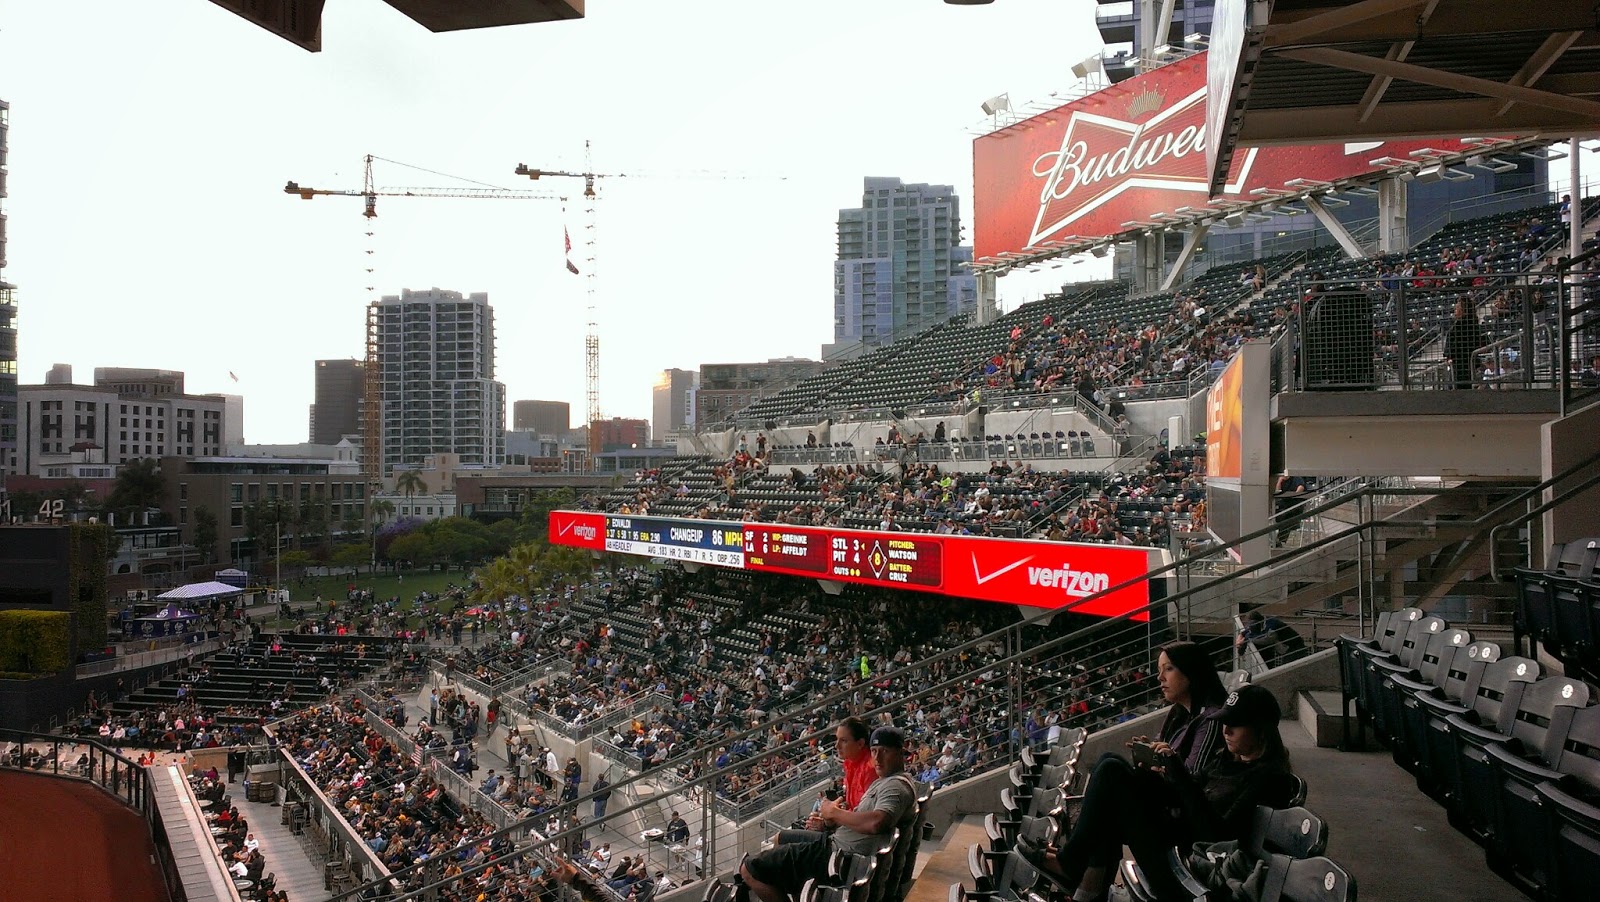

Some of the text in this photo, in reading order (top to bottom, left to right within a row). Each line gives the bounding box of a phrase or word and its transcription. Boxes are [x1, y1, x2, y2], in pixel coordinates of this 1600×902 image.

[39, 499, 64, 517] 42
[573, 522, 596, 541] verizon
[640, 532, 650, 542] ERA
[670, 527, 743, 547] CHANGEUP 86 MPH
[745, 531, 768, 543] SF 2
[782, 533, 807, 544] GREINKE
[832, 537, 859, 551] STL 3
[889, 540, 915, 549] PITCHER:
[612, 542, 633, 552] HEADLEY
[745, 542, 768, 554] LA 6
[772, 544, 807, 556] LP: AFFELDT
[648, 546, 656, 554] AVG
[669, 547, 676, 557] HR
[683, 549, 692, 559] RBI
[717, 553, 728, 563] OBP
[833, 550, 860, 563] PIT 4
[874, 552, 881, 566] 8
[888, 550, 917, 561] WATSON
[750, 556, 764, 566] FINAL
[833, 566, 849, 576] OUTS
[889, 563, 913, 573] BATTER:
[889, 572, 907, 582] CRUZ
[1028, 563, 1109, 597] verizon
